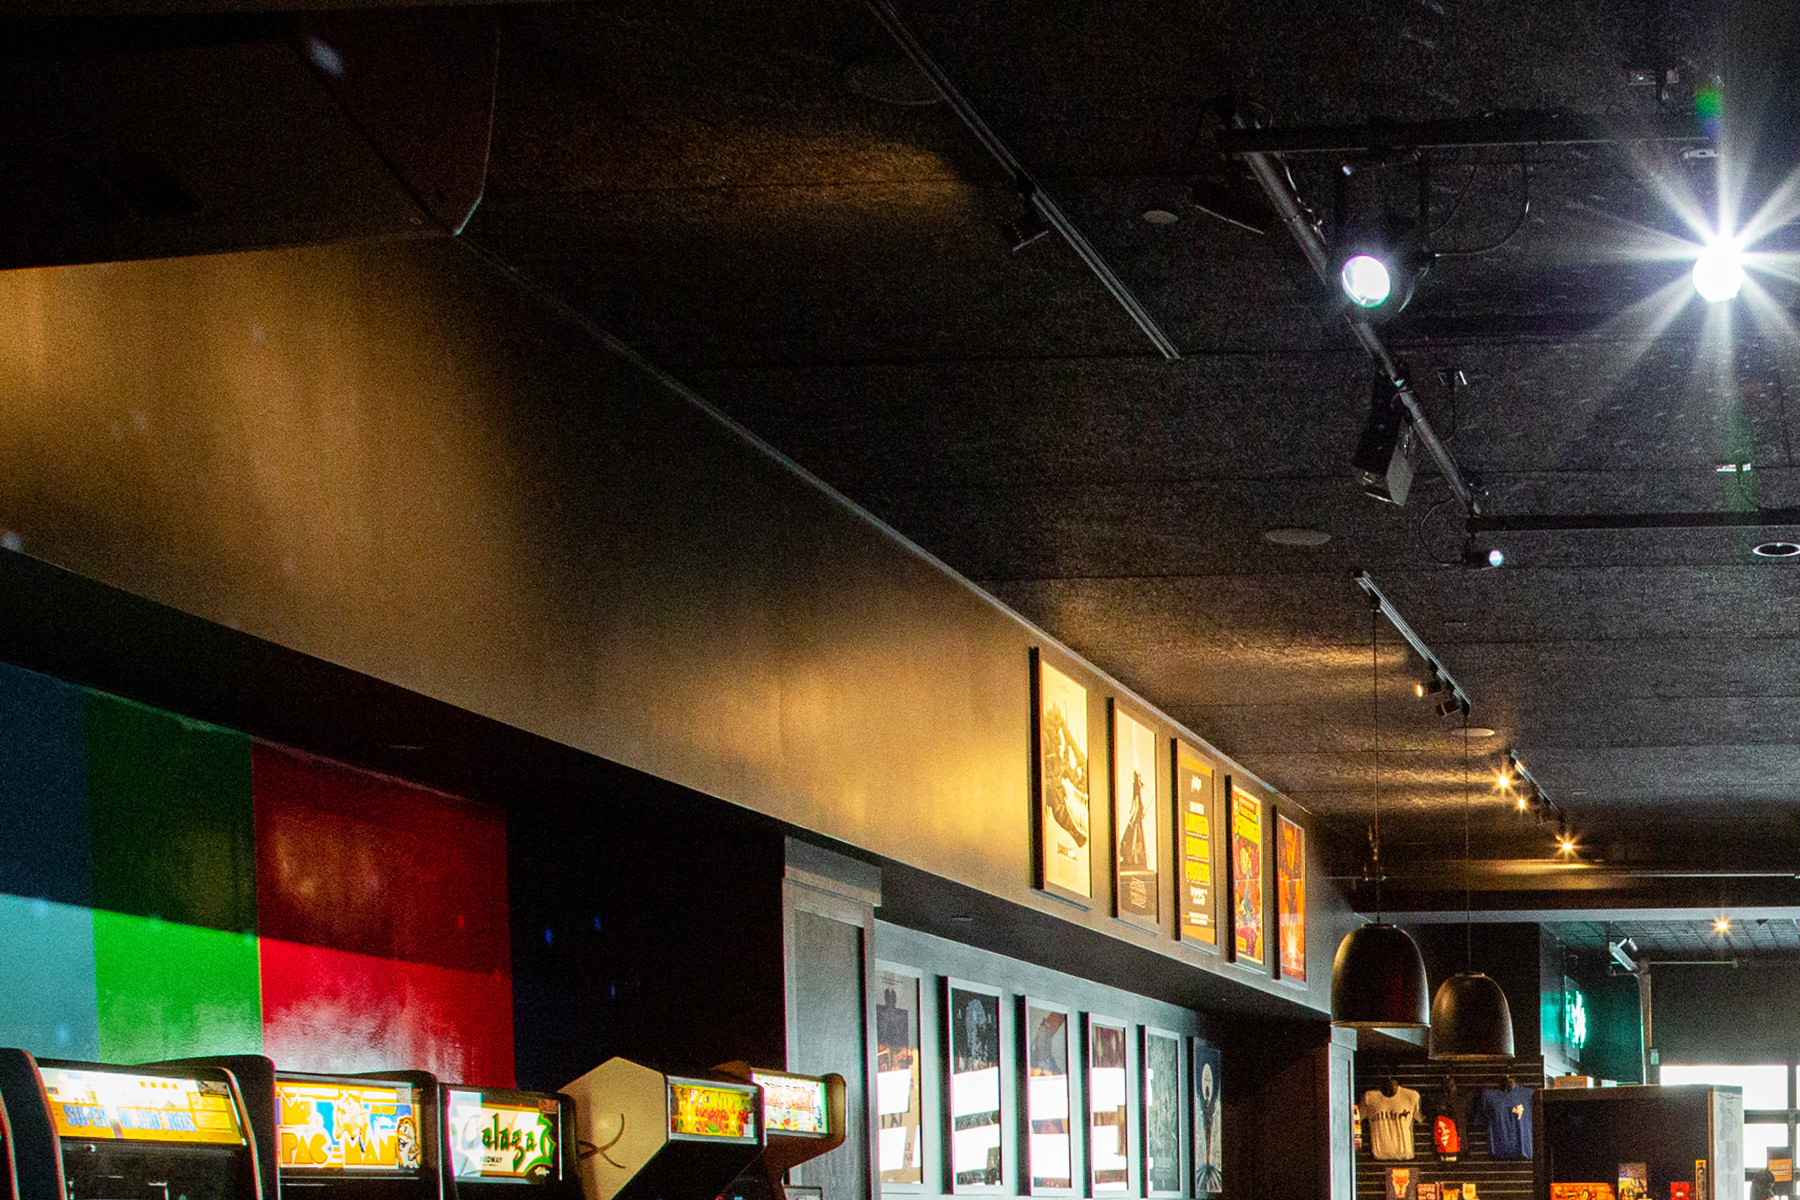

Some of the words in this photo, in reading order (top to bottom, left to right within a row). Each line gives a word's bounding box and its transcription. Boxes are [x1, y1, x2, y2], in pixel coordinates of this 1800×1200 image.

[63, 1104, 111, 1128] SUPER
[279, 1121, 399, 1168] PAC-MAN
[460, 1112, 538, 1173] Galaga
